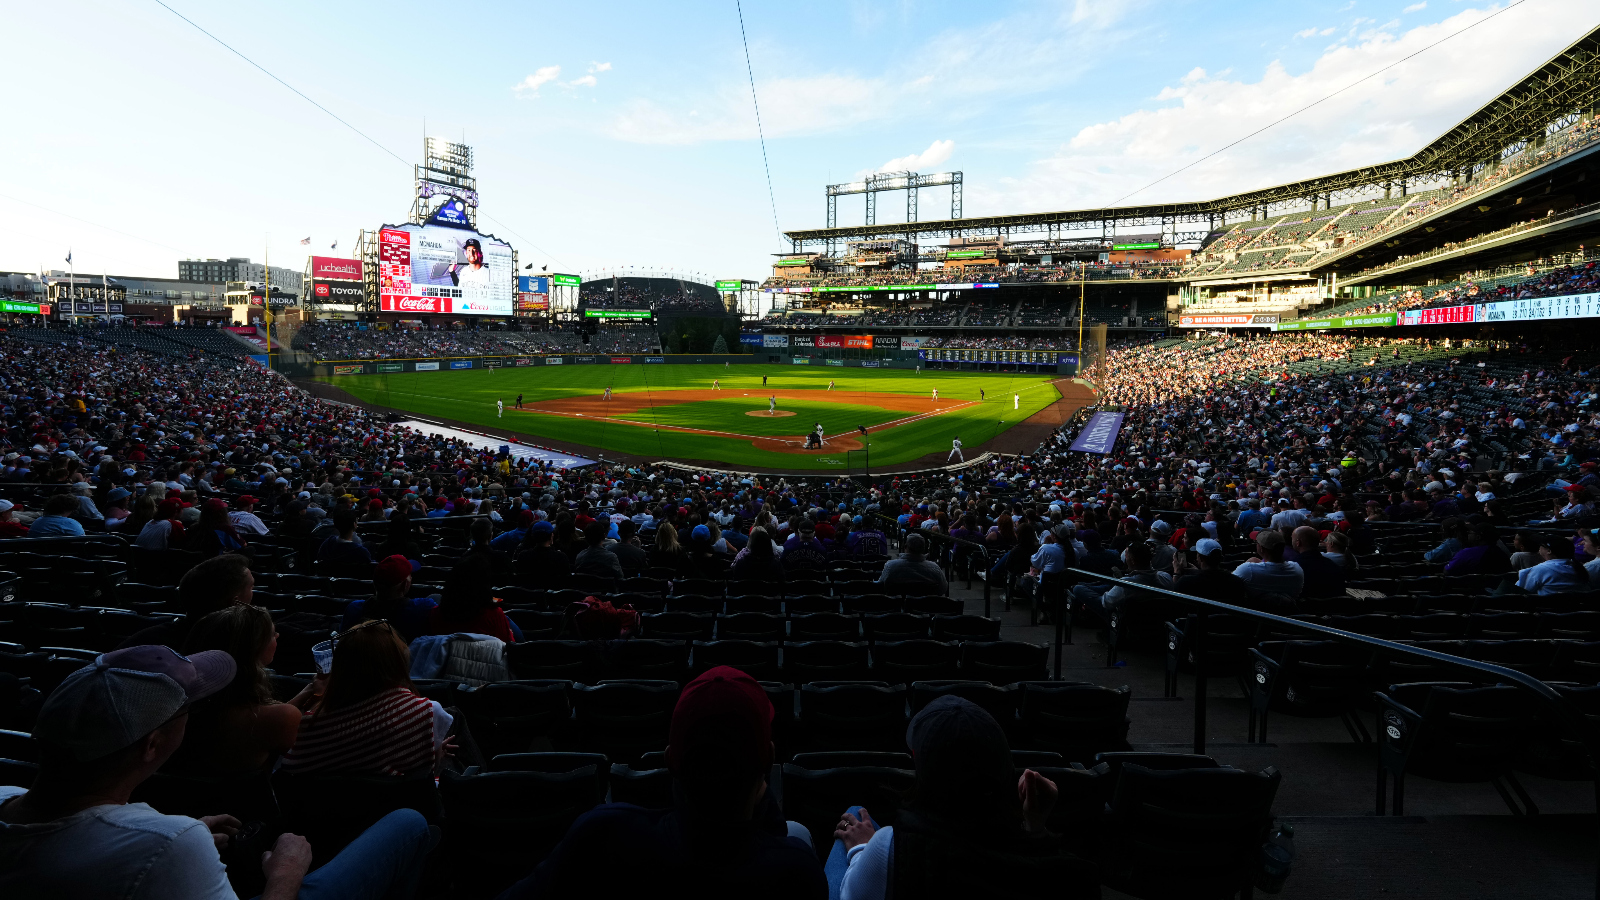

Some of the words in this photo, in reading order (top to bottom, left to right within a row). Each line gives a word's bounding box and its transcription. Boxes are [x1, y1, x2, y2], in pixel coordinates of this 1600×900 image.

[420, 181, 479, 207] ROCKIES
[320, 263, 357, 273] uchealth
[331, 287, 363, 295] TOYOTA
[263, 297, 295, 305] TUNDRA
[524, 294, 544, 302] KING
[399, 297, 436, 311] Coca-Cola
